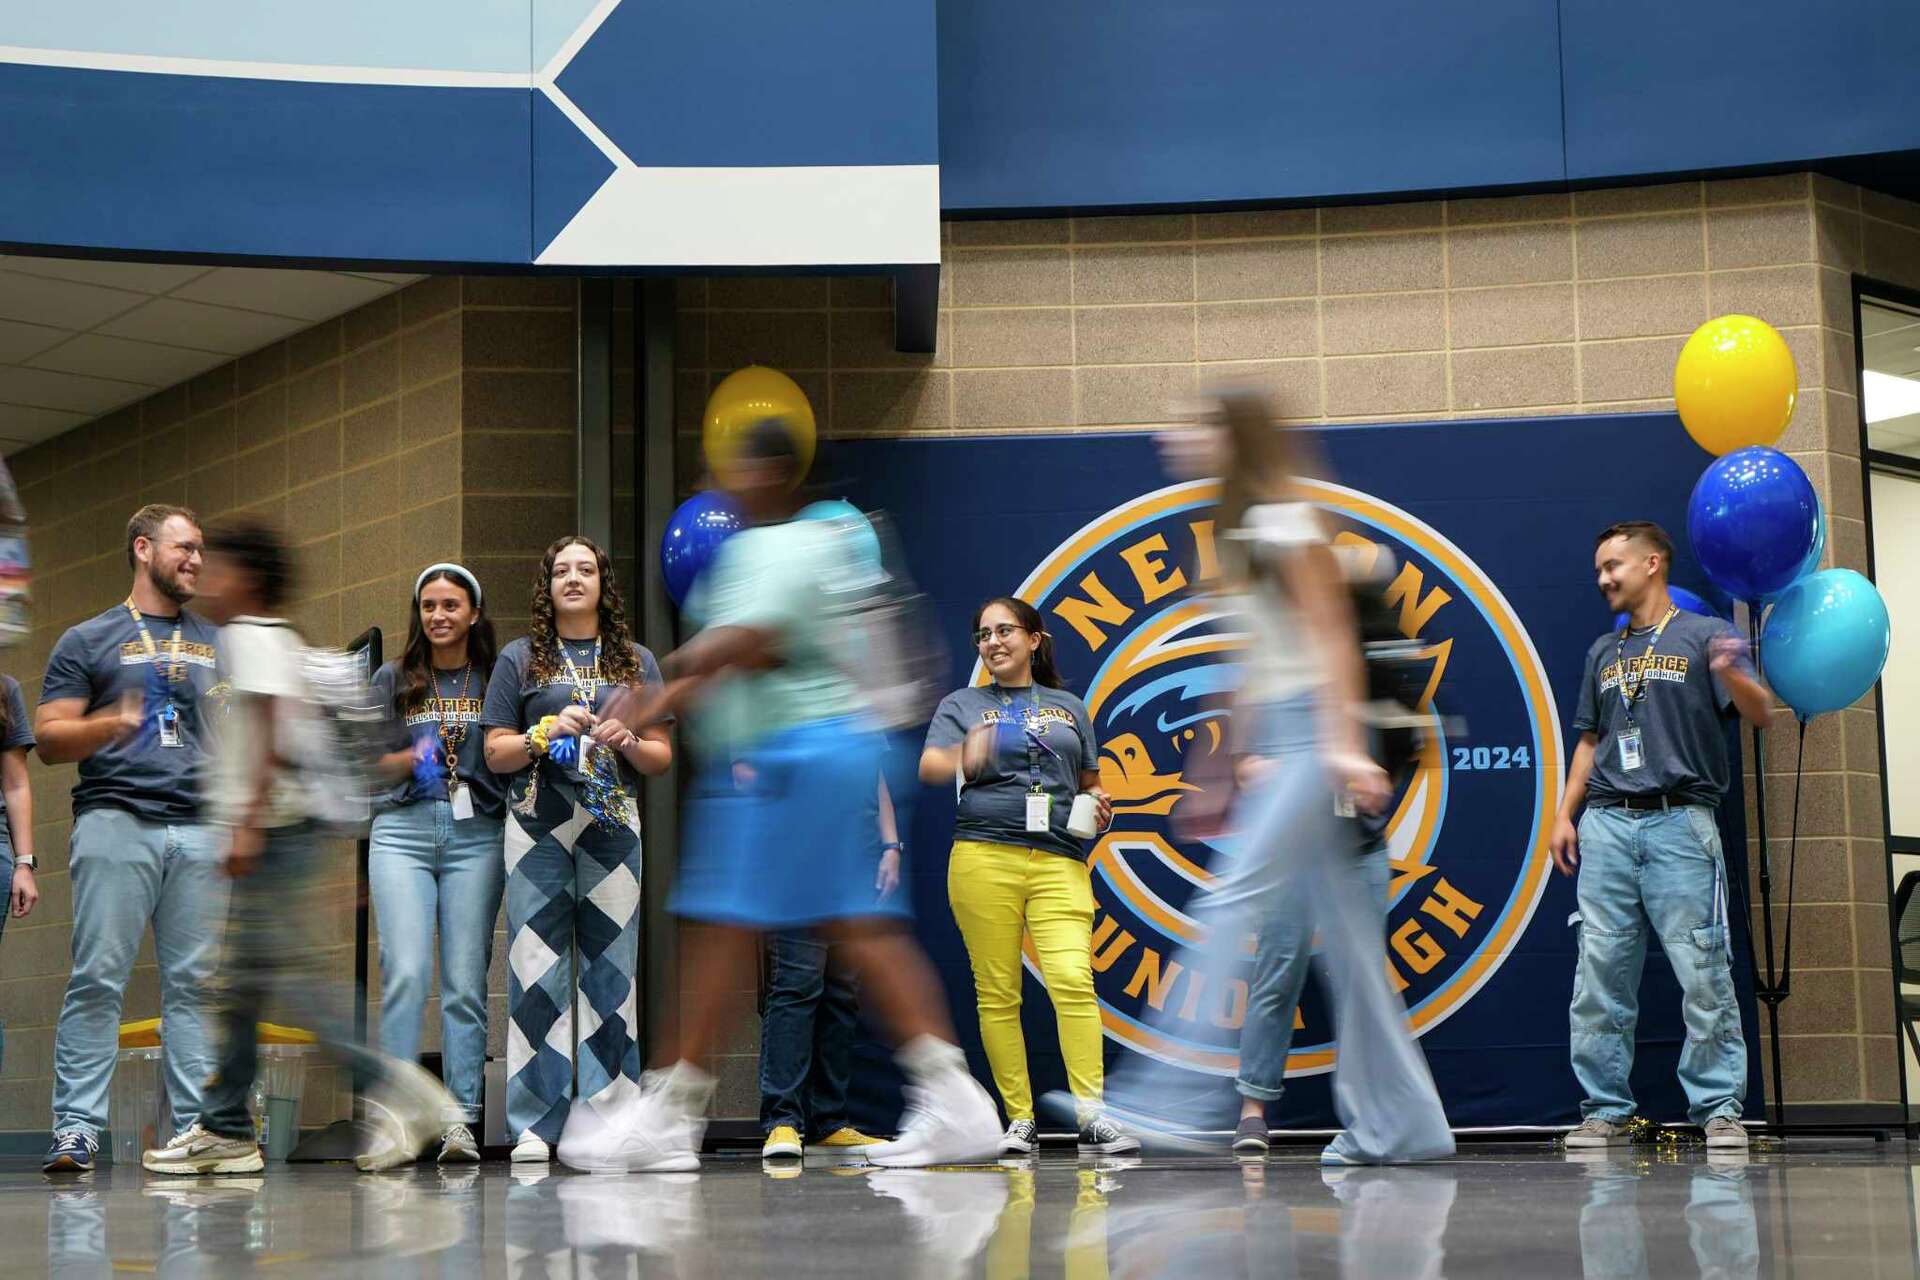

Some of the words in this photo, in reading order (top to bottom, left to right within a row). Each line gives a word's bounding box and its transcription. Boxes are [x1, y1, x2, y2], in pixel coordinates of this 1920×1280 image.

[1052, 519, 1453, 652] NELON
[1452, 745, 1531, 770] 2024
[1091, 897, 1306, 1030] UNIO
